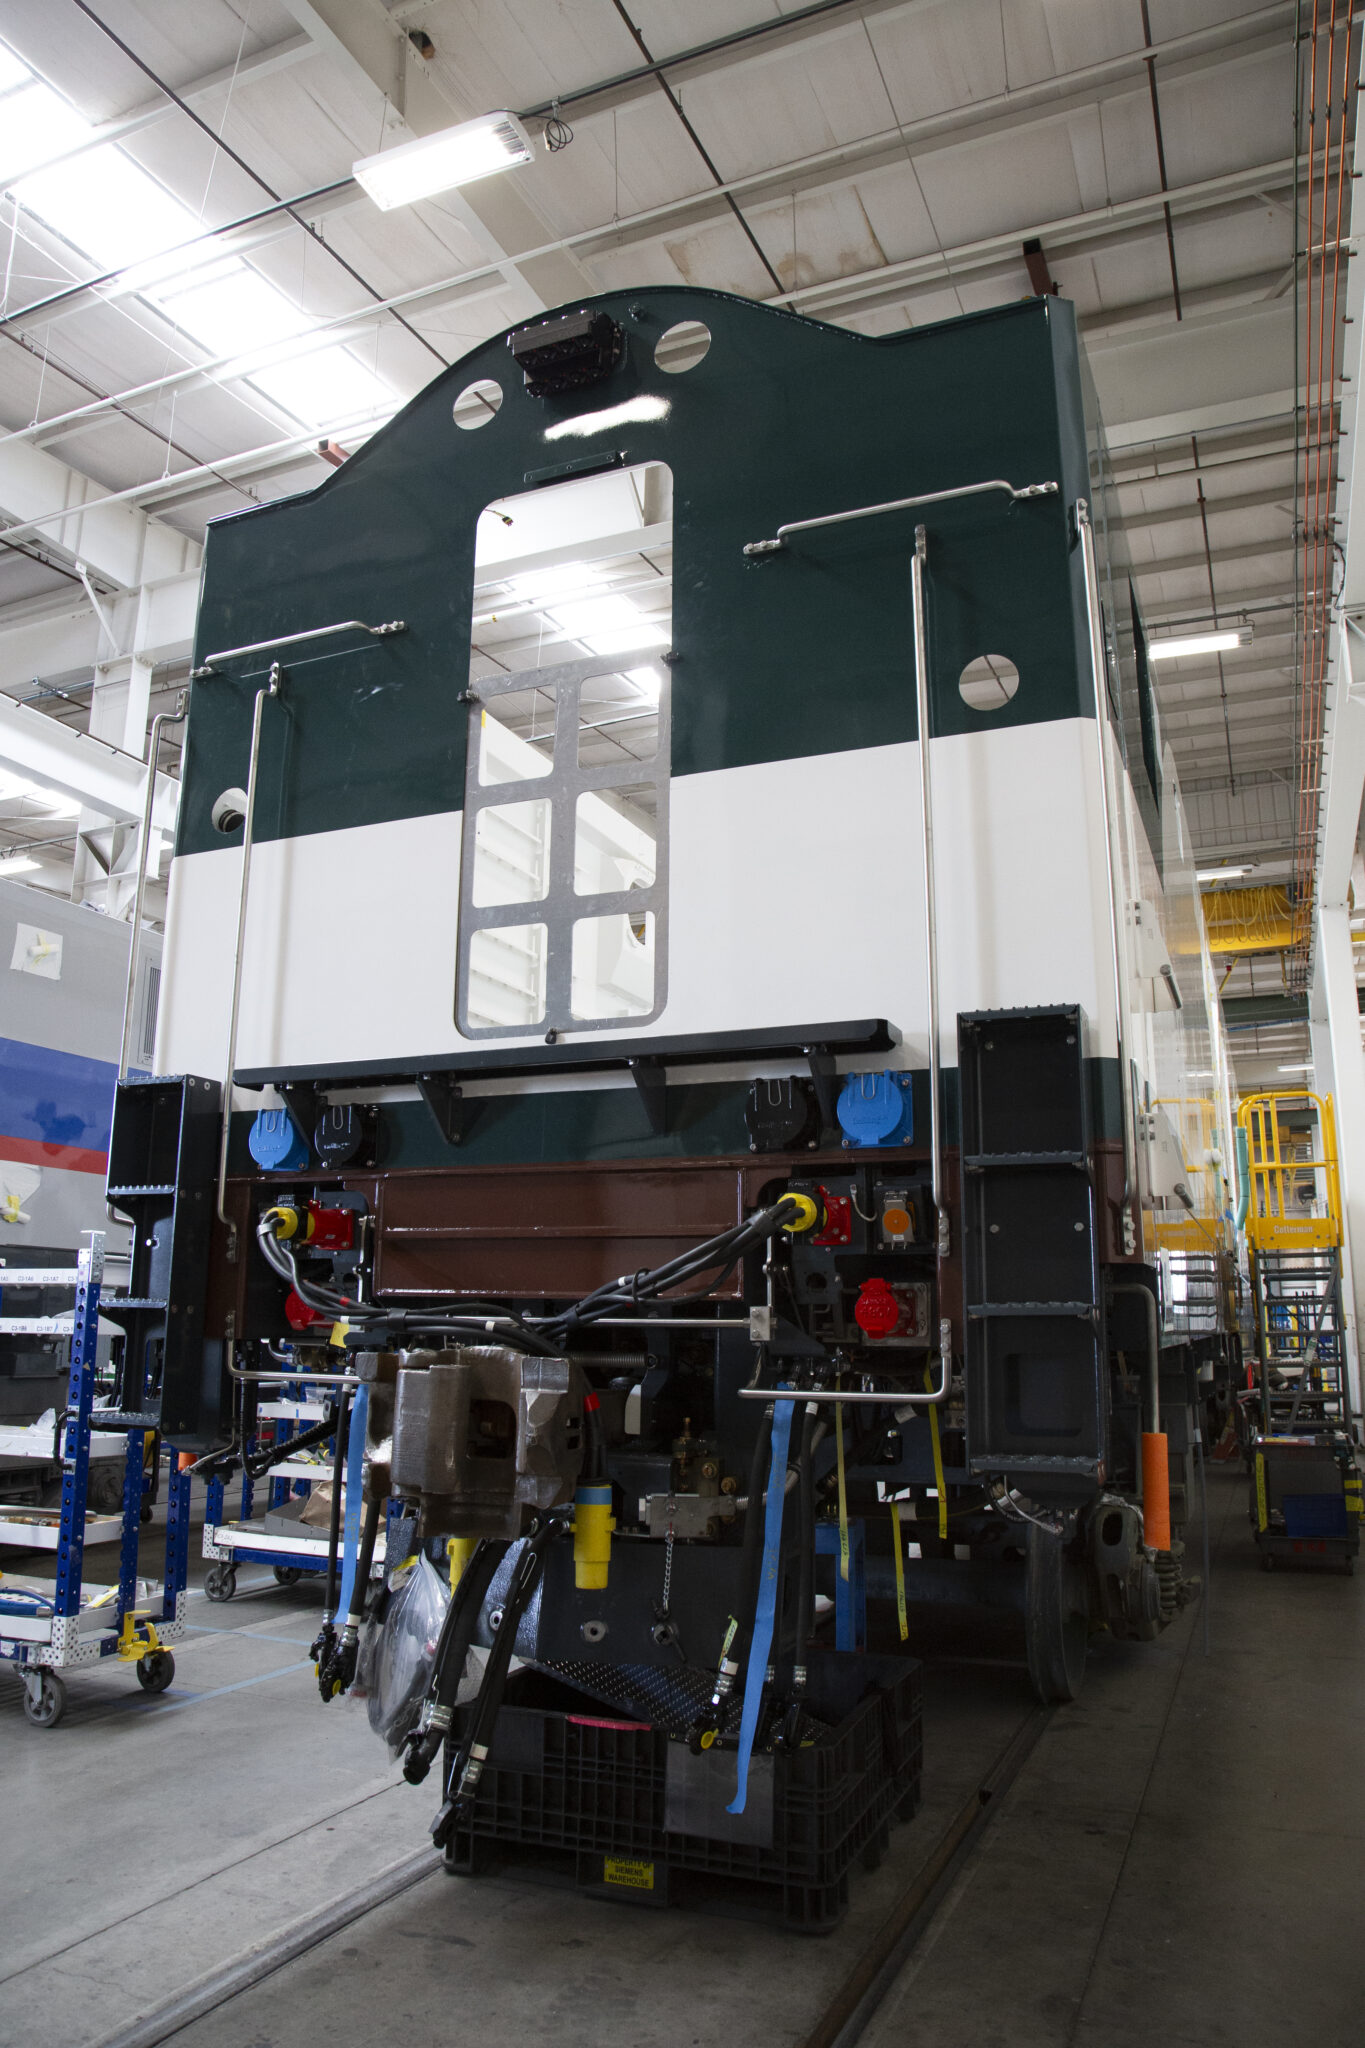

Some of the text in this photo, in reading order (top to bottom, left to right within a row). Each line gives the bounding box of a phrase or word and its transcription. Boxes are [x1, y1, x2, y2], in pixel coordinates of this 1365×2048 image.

[1274, 1225, 1313, 1234] Cotterman
[607, 1855, 642, 1868] PROPERTY
[615, 1865, 644, 1877] SIEMENS
[608, 1873, 650, 1887] WAREHOUSE
